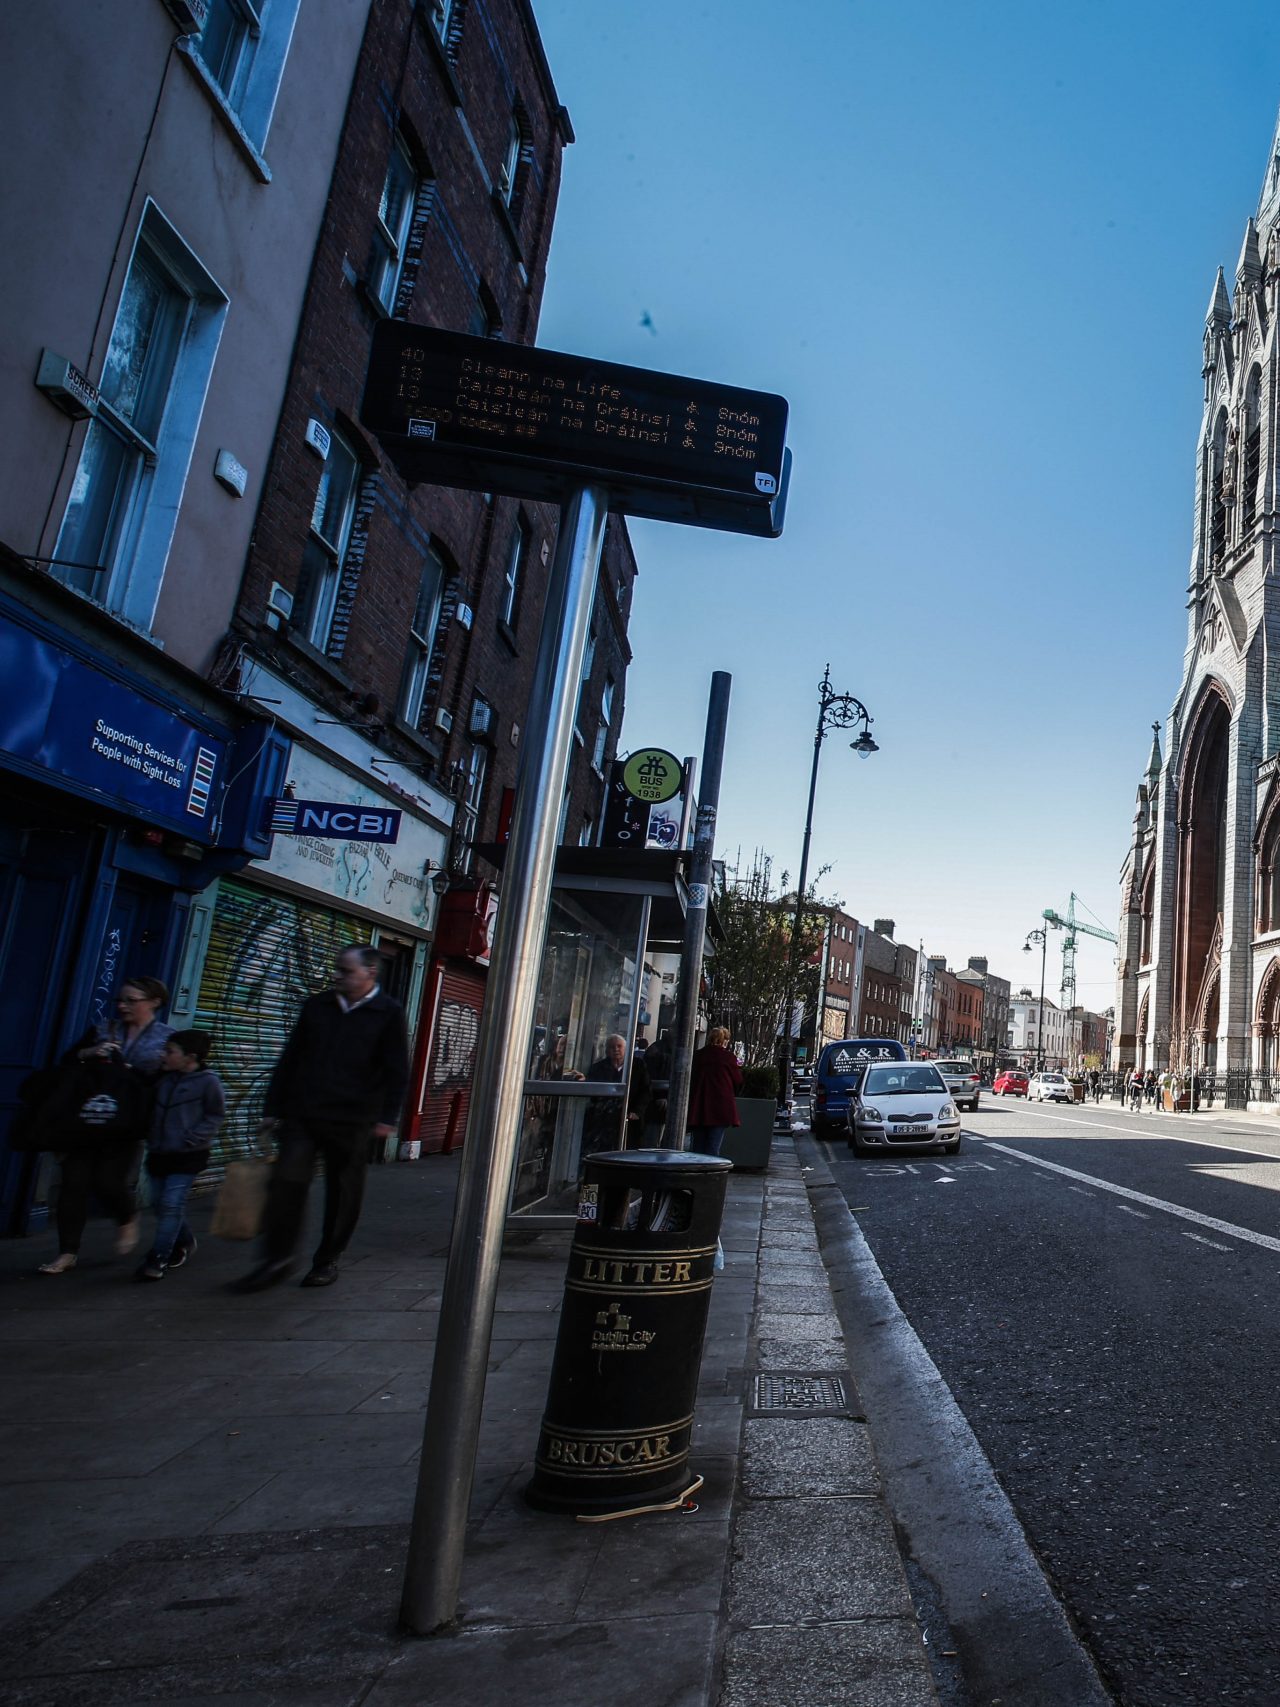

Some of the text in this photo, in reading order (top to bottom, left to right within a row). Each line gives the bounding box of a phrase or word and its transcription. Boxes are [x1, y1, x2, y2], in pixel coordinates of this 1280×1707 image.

[461, 357, 530, 382] Gleann
[543, 376, 565, 389] na
[562, 397, 585, 411] na
[560, 414, 583, 429] na
[757, 478, 774, 488] TFI
[96, 719, 188, 773] Supporting Services for
[92, 737, 181, 788] People with Sight Loss
[640, 775, 663, 786] BUS
[638, 789, 661, 799] 1938
[302, 808, 393, 836] NCBI
[837, 1047, 891, 1059] A & R
[583, 1259, 692, 1283] LITTER
[593, 1330, 657, 1344] Dublin City
[547, 1436, 671, 1465] BRUSCAR
